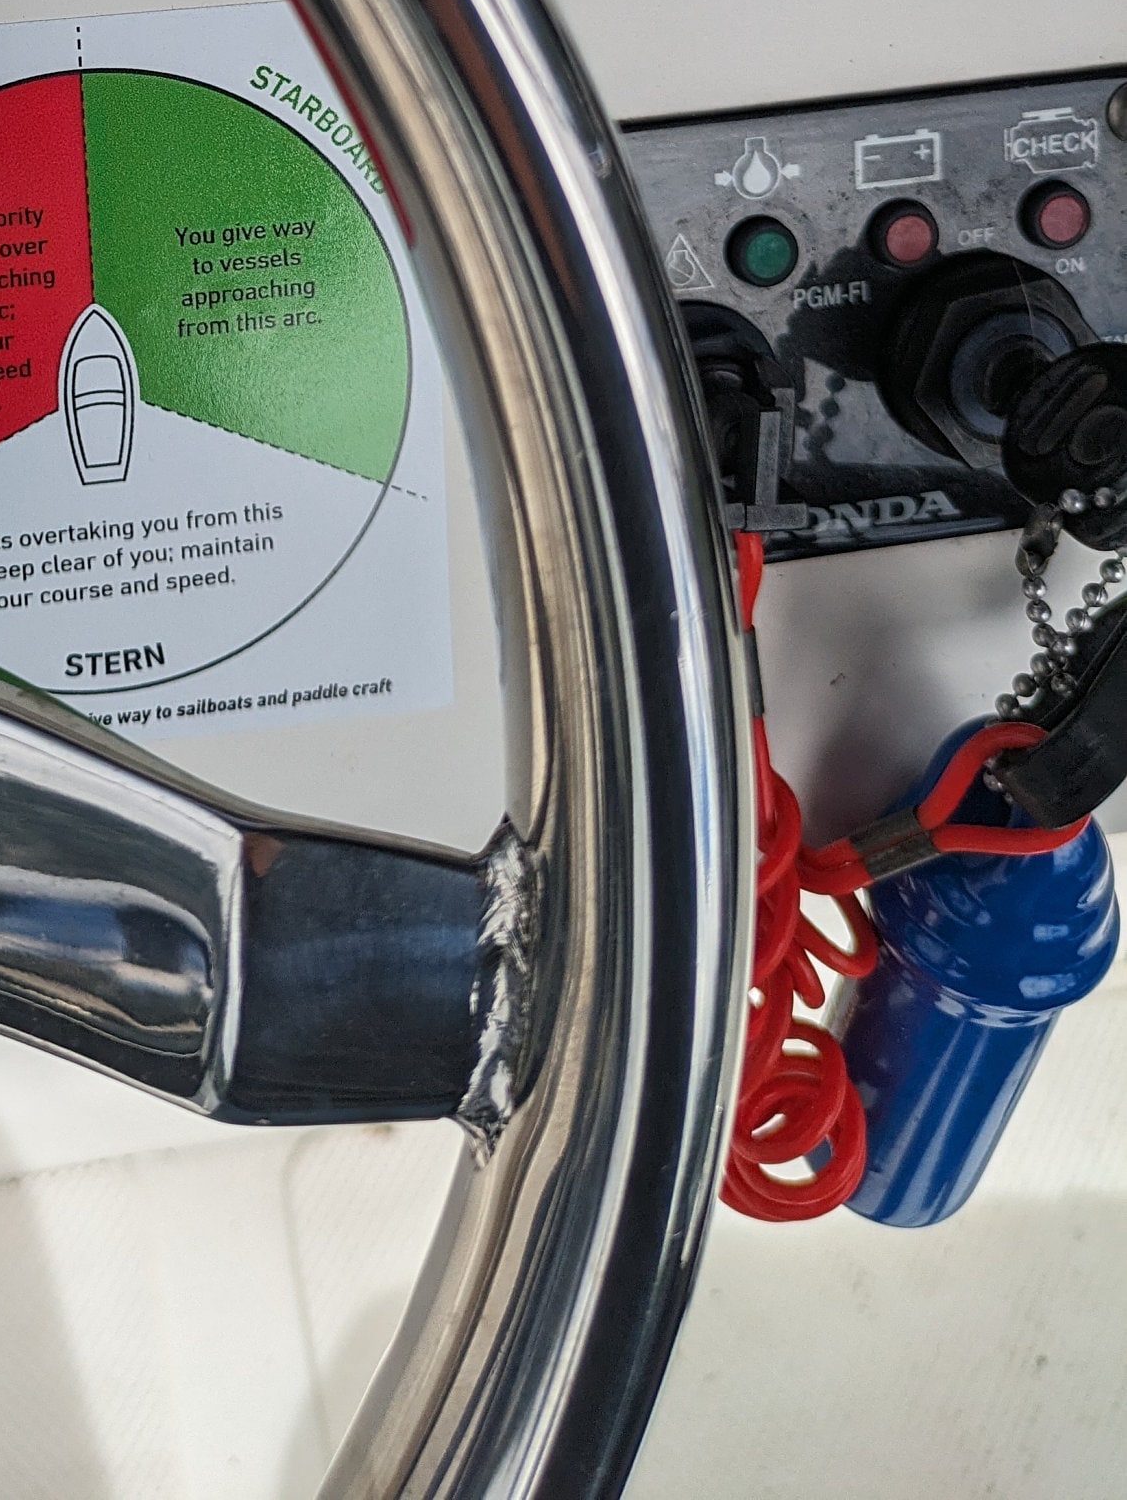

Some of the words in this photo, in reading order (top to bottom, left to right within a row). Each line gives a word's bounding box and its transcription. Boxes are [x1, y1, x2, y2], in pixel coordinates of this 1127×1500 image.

[1012, 129, 1097, 160] CHECK
[0, 239, 49, 258] over
[175, 227, 216, 247] You
[221, 222, 267, 248] give
[272, 219, 317, 239] way
[957, 226, 997, 247] OFF
[192, 256, 214, 276] to
[219, 248, 303, 273] vessels
[1054, 257, 1087, 276] ON
[181, 278, 316, 310] approaching
[792, 279, 872, 311] PGM-FI
[177, 317, 231, 338] from
[235, 311, 277, 333] this
[283, 309, 324, 328] arc.
[19, 519, 135, 547] overtaking
[140, 515, 180, 539] you
[185, 507, 238, 531] from
[243, 501, 284, 524] this
[806, 490, 961, 532] ONDA
[40, 553, 98, 575] clear
[102, 546, 126, 569] of
[180, 532, 275, 560] maintain
[39, 582, 115, 605] course
[119, 572, 160, 596] and
[165, 566, 237, 594] speed.
[63, 640, 167, 678] STERN
[117, 707, 153, 725] way
[155, 703, 173, 720] to
[176, 694, 254, 717] sailboats
[256, 688, 290, 708] and
[291, 682, 349, 708] paddle
[351, 676, 393, 697] craft
